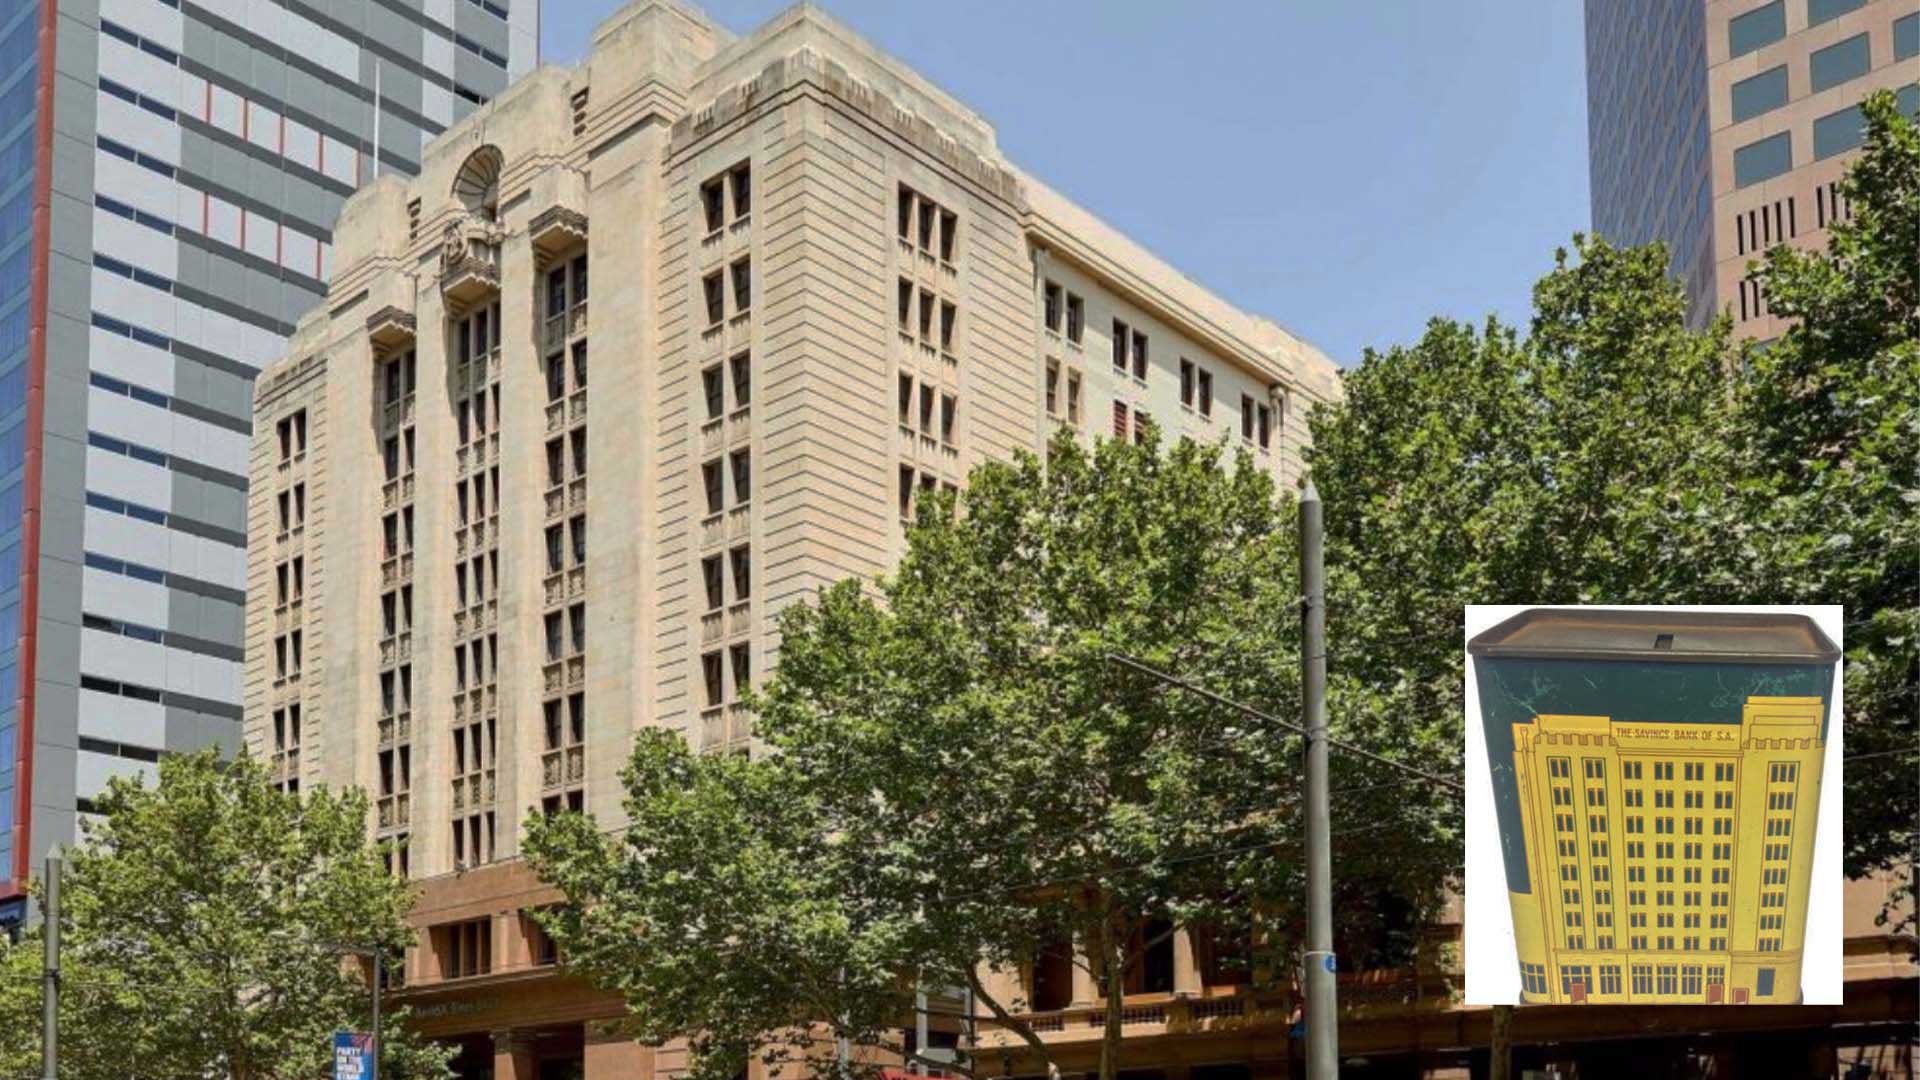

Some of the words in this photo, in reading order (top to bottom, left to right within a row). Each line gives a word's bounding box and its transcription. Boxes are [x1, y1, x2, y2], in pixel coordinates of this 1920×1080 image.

[1616, 727, 1633, 738] THE
[1673, 729, 1698, 740] BANK
[1701, 730, 1712, 741] OF
[337, 1047, 361, 1056] PARTY
[337, 1064, 364, 1073] WORLD
